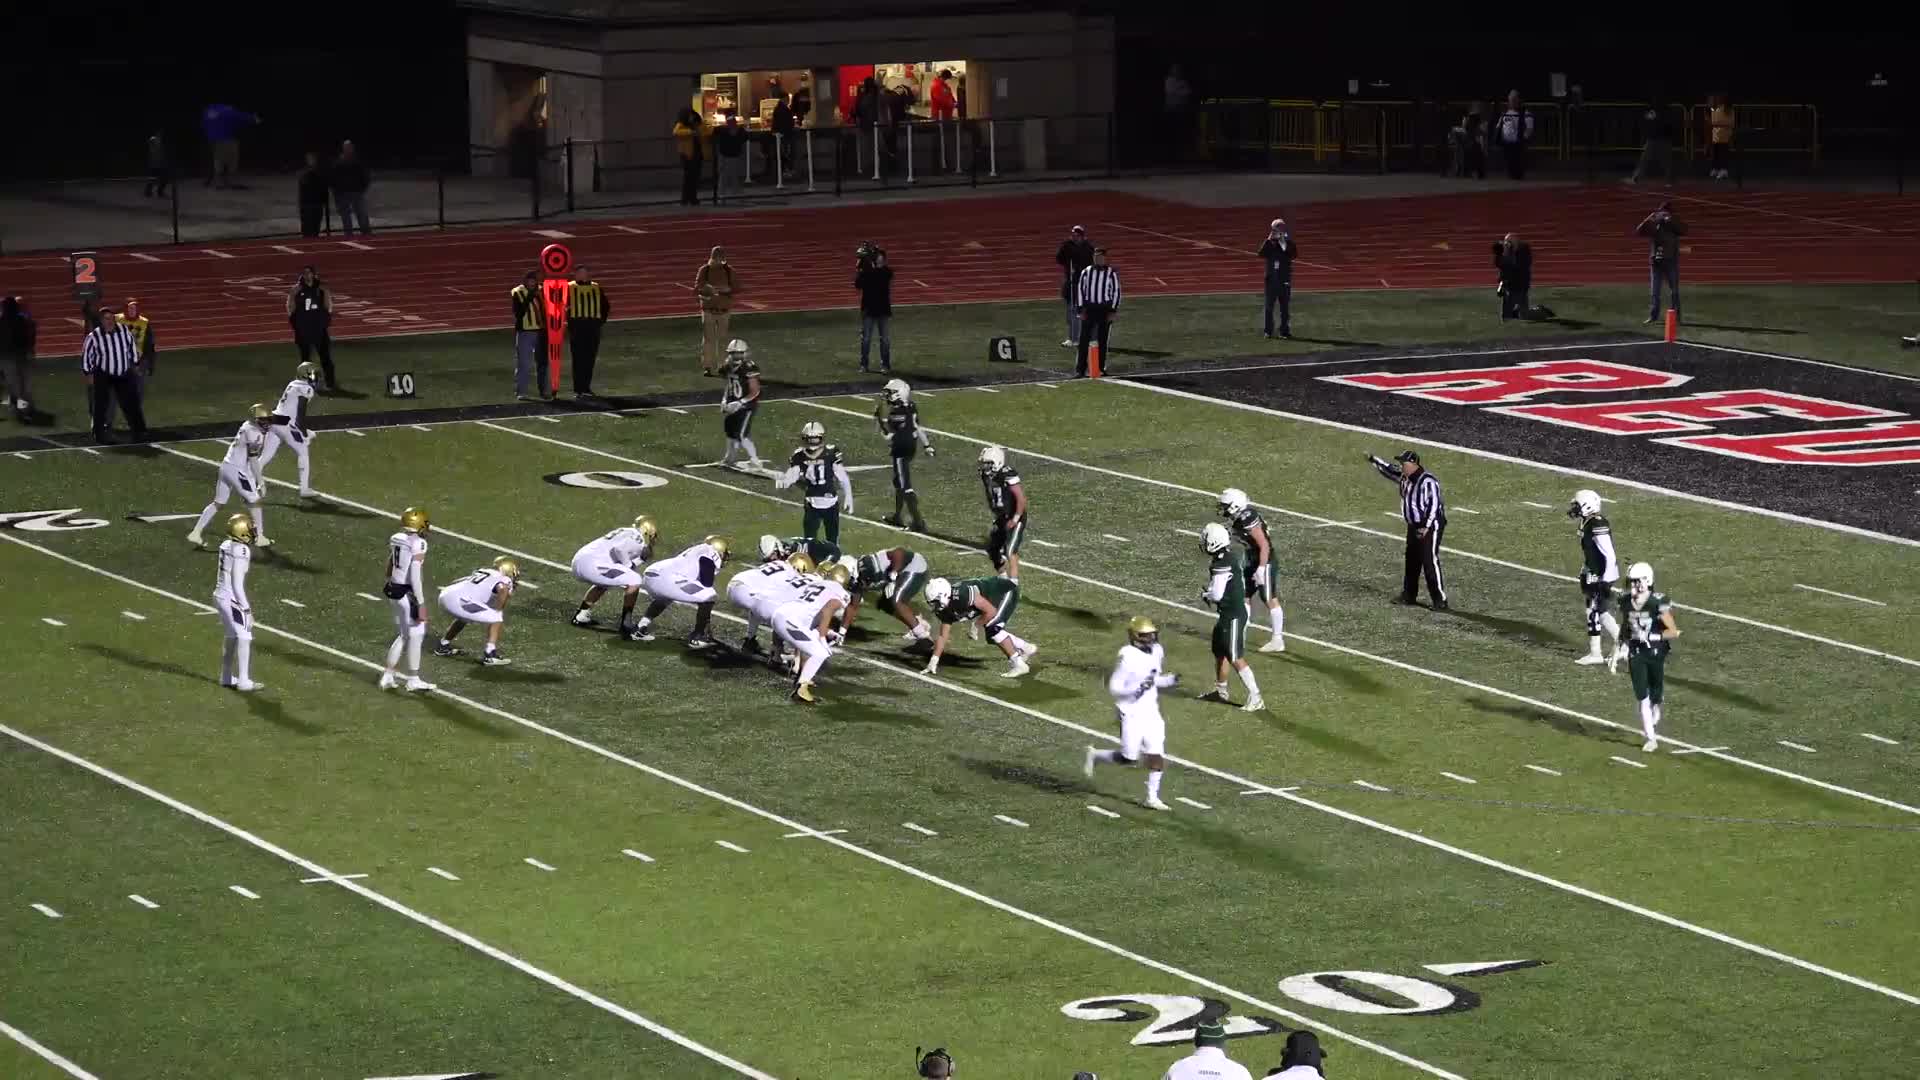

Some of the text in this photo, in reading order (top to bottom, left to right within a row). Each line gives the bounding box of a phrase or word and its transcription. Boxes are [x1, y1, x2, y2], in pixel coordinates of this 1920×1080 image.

[75, 257, 97, 284] 2
[997, 338, 1012, 360] G
[390, 374, 414, 395] 10
